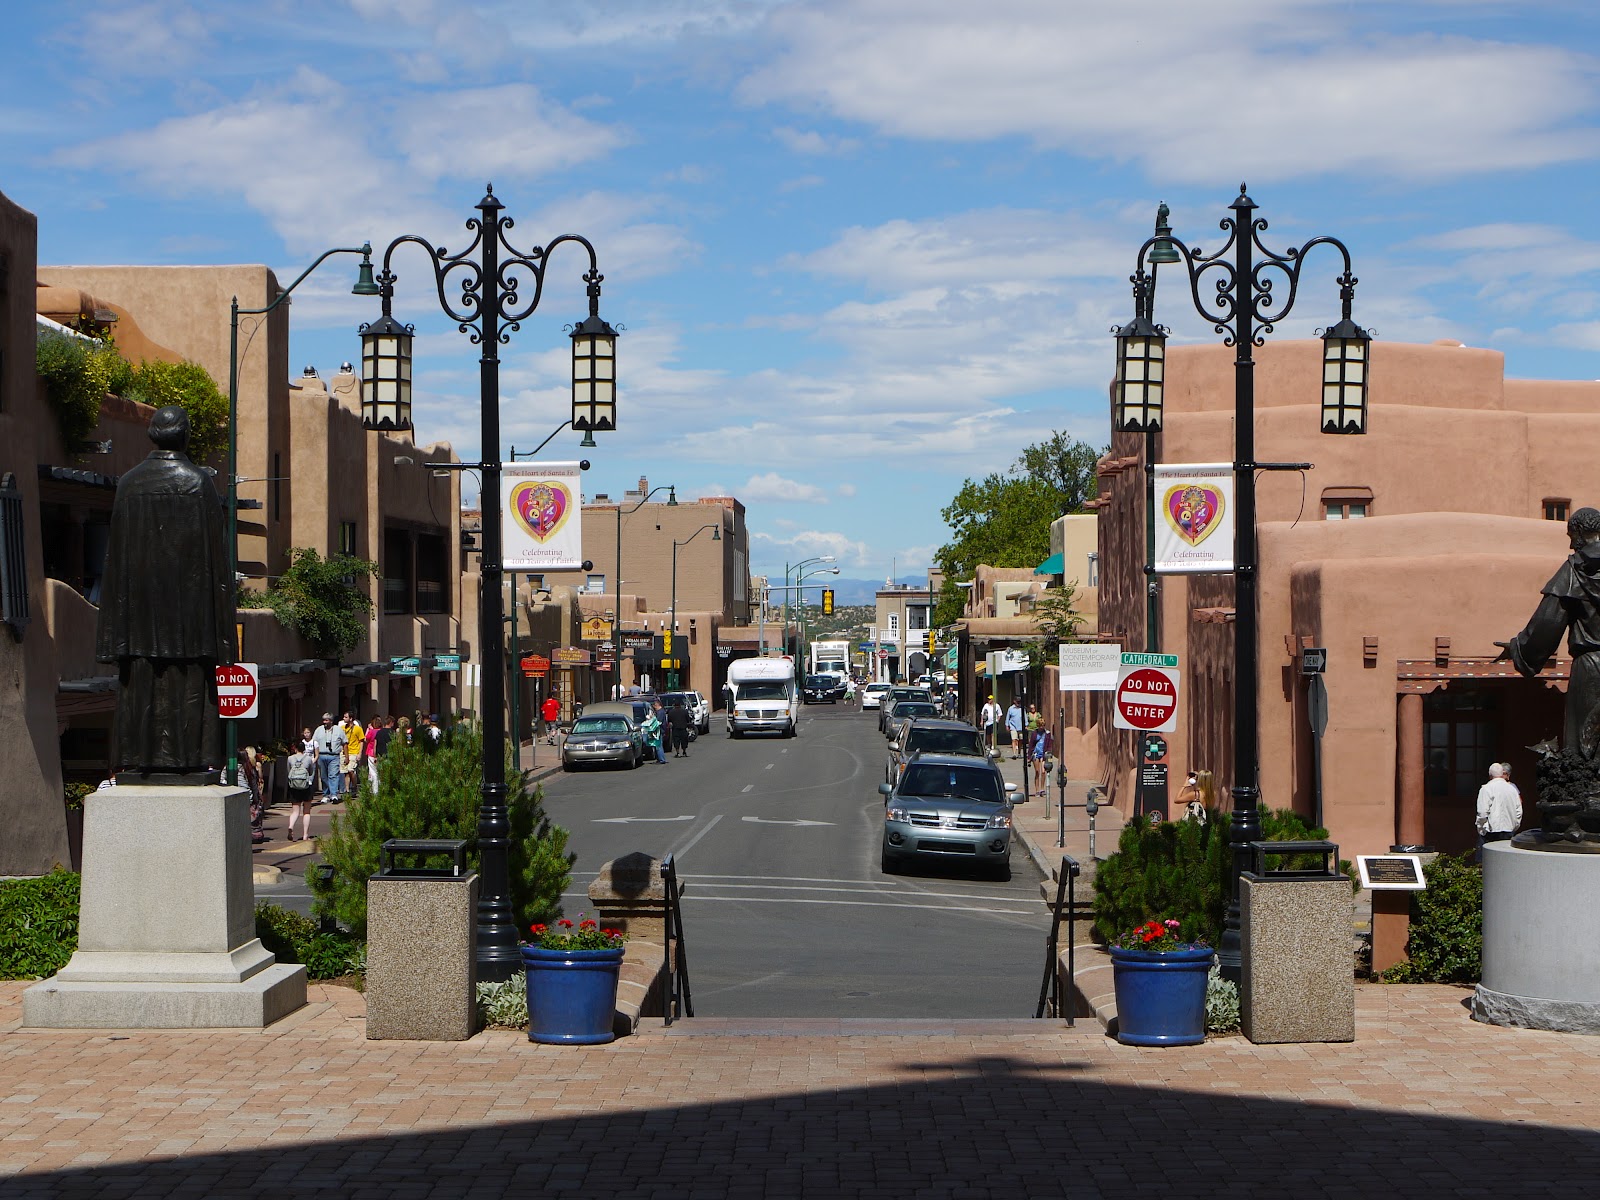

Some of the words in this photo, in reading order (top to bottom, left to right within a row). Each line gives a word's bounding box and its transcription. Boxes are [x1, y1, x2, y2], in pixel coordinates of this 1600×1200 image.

[1192, 470, 1200, 478] of
[522, 548, 562, 556] Celebrating
[1174, 550, 1214, 559] Celebrating
[547, 557, 555, 566] of
[1124, 654, 1166, 665] CATHEDRAL
[230, 675, 249, 683] NOT
[1128, 679, 1142, 689] DO
[1148, 681, 1169, 692] NOT
[221, 698, 247, 706] NTER
[1127, 706, 1164, 718] ENTER
